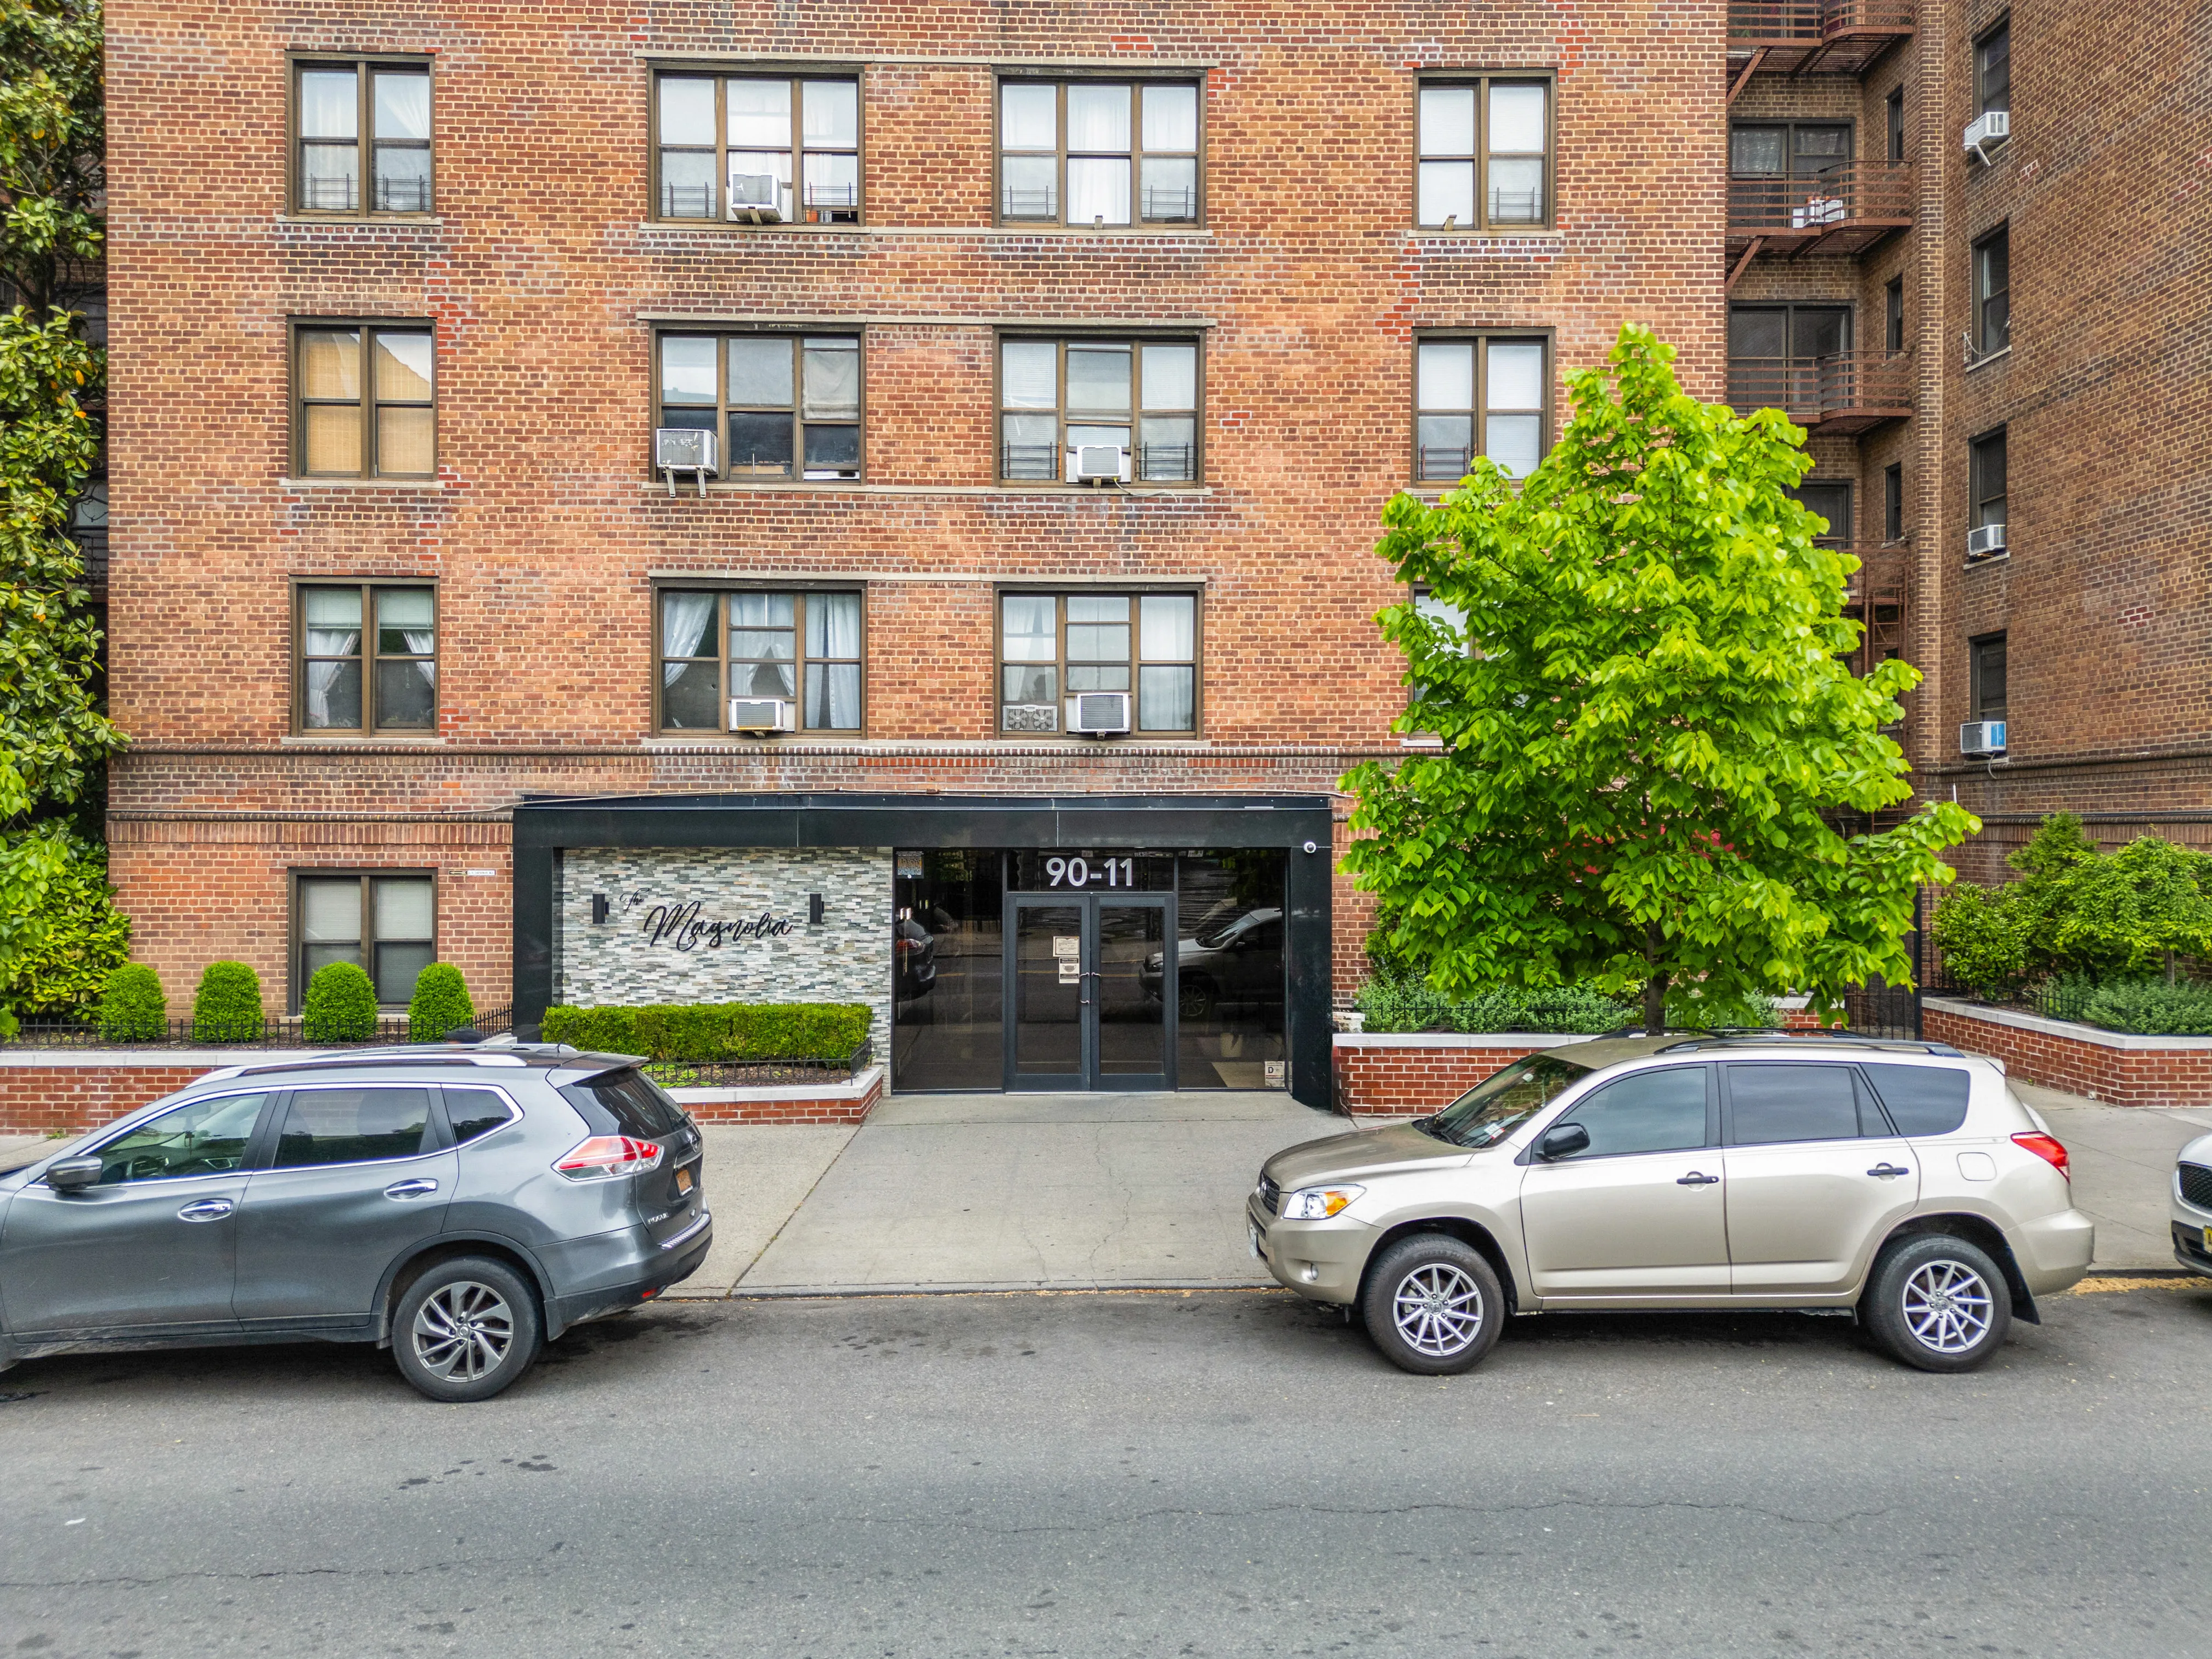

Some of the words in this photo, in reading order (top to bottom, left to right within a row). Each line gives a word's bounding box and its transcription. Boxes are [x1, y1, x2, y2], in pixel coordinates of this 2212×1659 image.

[1046, 857, 1132, 887] 90-11
[619, 888, 650, 911] The
[644, 900, 794, 951] Magnolia
[647, 1212, 669, 1224] ROGUE
